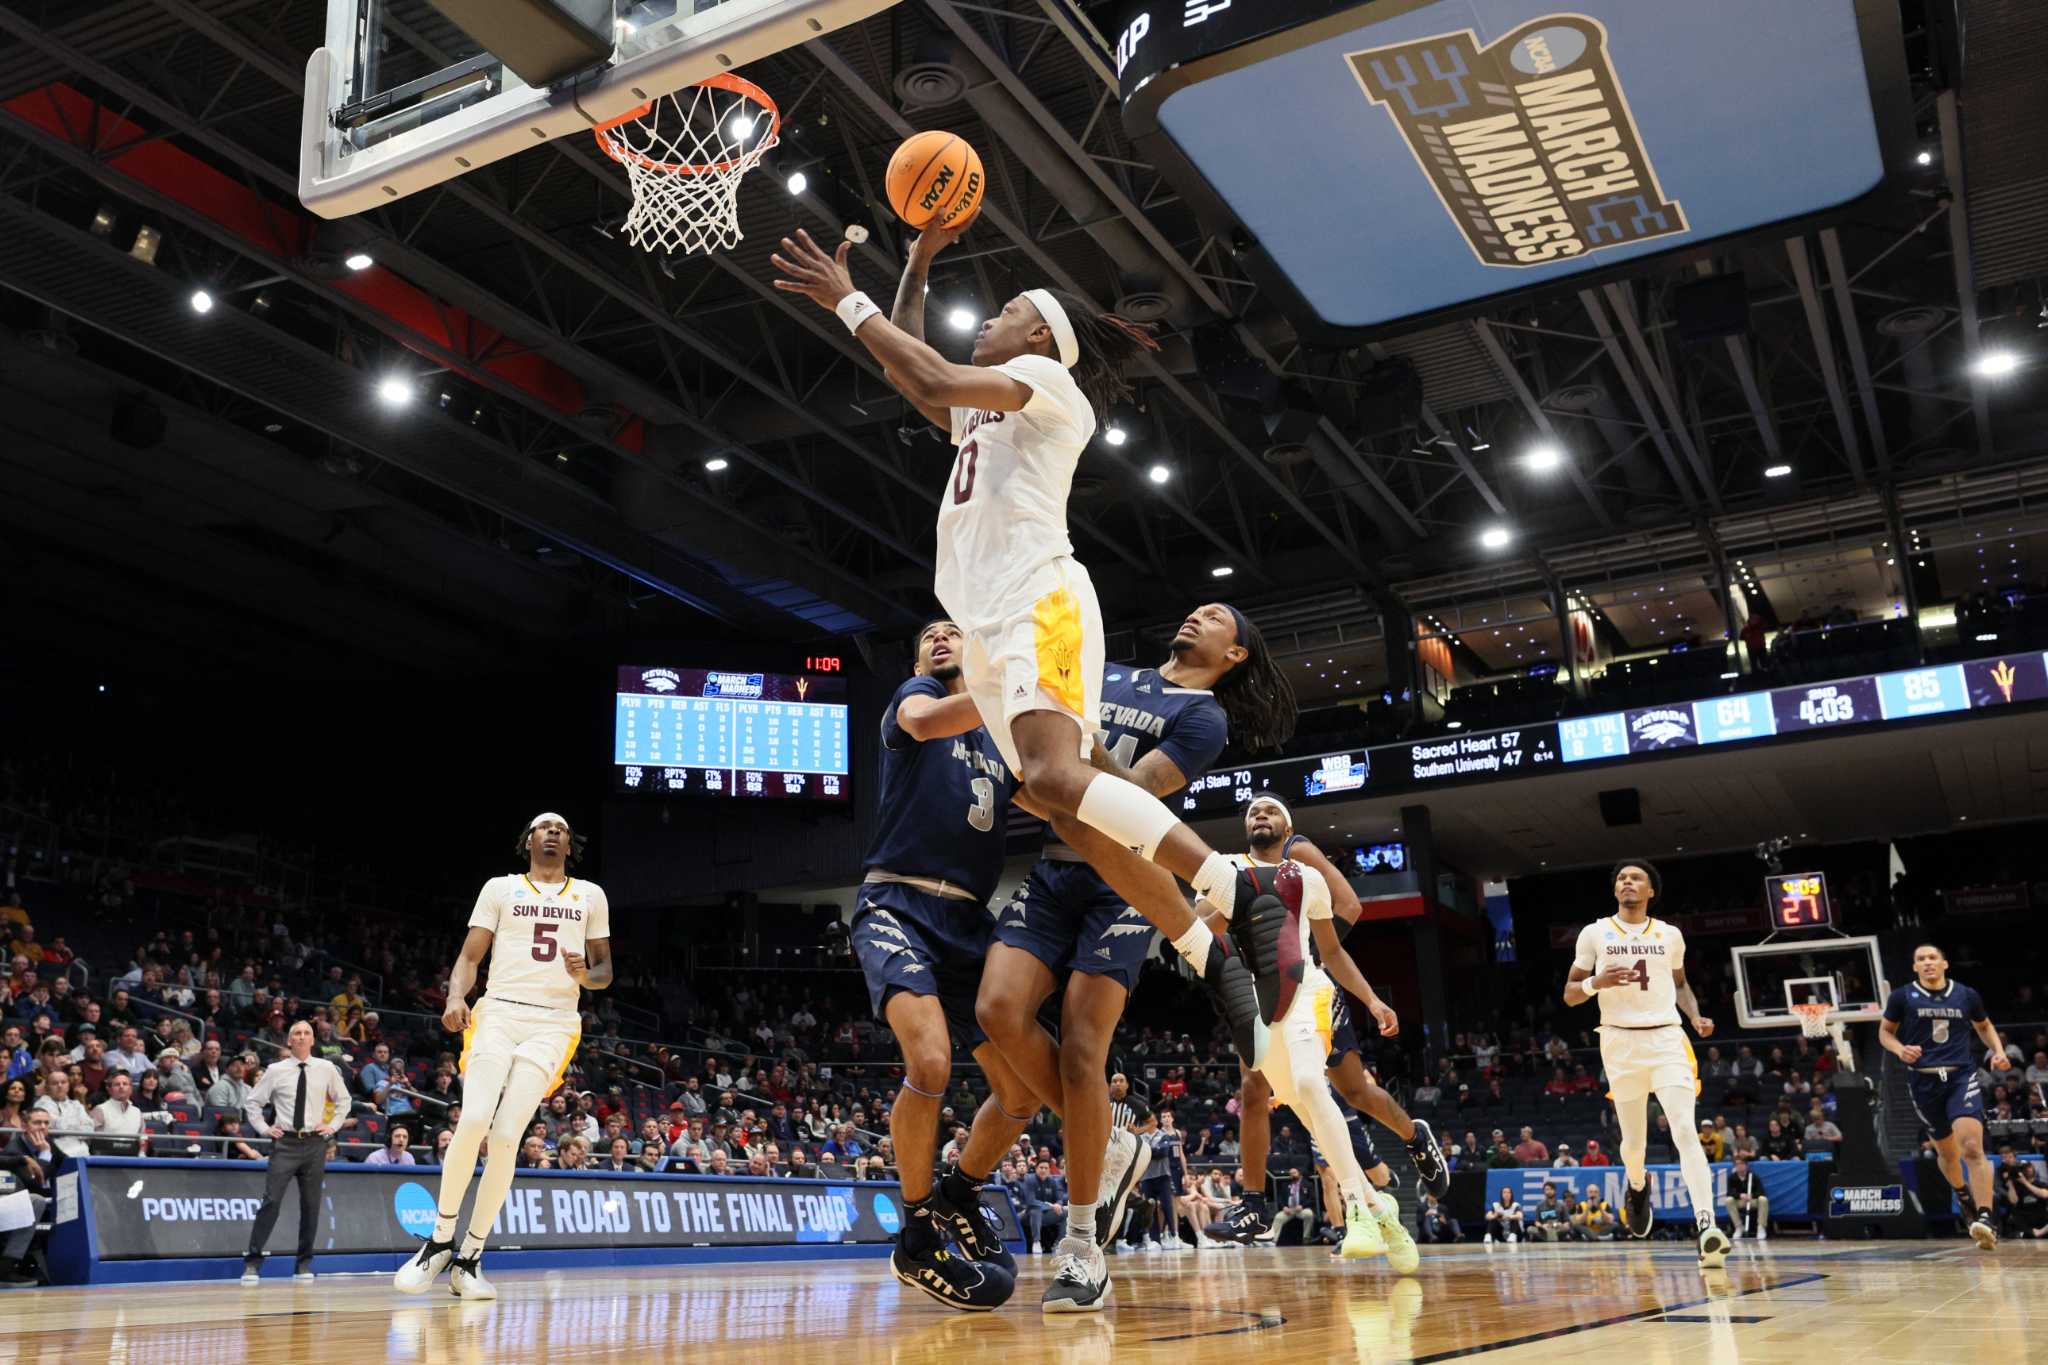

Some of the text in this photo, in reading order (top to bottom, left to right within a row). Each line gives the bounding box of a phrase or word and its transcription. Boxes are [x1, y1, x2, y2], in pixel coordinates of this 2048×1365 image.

[1523, 36, 1557, 74] NCAA
[1514, 68, 1640, 201] MARCH
[920, 164, 955, 210] NCAA
[1441, 112, 1584, 262] MADNESS
[954, 438, 978, 505] 0
[806, 656, 840, 671] 11:09
[641, 669, 681, 683] NEVADA
[717, 674, 747, 686] MARCH
[1904, 670, 1941, 701] 85
[830, 708, 845, 718] FLS
[1632, 710, 1690, 732] NEVADA
[1717, 697, 1751, 726] 64
[1800, 695, 1854, 725] 4:03
[1563, 721, 1588, 739] FLS
[1412, 731, 1545, 761] Sacred Heart 57 4
[1321, 754, 1351, 770] WBB
[1413, 759, 1454, 779] Southern
[1455, 754, 1500, 774] University
[1503, 750, 1522, 767] 47
[625, 776, 640, 787] 47
[664, 768, 687, 779] 3PT%
[705, 770, 722, 781] FT%
[783, 773, 806, 784] 3PT%
[823, 775, 840, 786] FT%
[1207, 774, 1231, 789] State
[1234, 770, 1251, 785] 70
[967, 777, 994, 832] 3
[1235, 787, 1253, 802] 56
[513, 905, 582, 921] SUN DEVILS
[1782, 894, 1819, 924] 27
[531, 923, 559, 962] 5
[1606, 945, 1665, 955] SUN DEVILS
[1630, 959, 1650, 991] 4
[1917, 1008, 1962, 1018] NEVADA
[1844, 1188, 1882, 1201] MARCH
[1850, 1199, 1901, 1212] MADNESS
[142, 1197, 262, 1221] POWERAD
[551, 1189, 631, 1234] ROAD
[633, 1191, 671, 1233] TO
[673, 1192, 725, 1233] THE
[725, 1193, 793, 1233] FINAL
[792, 1194, 852, 1232] FOUR
